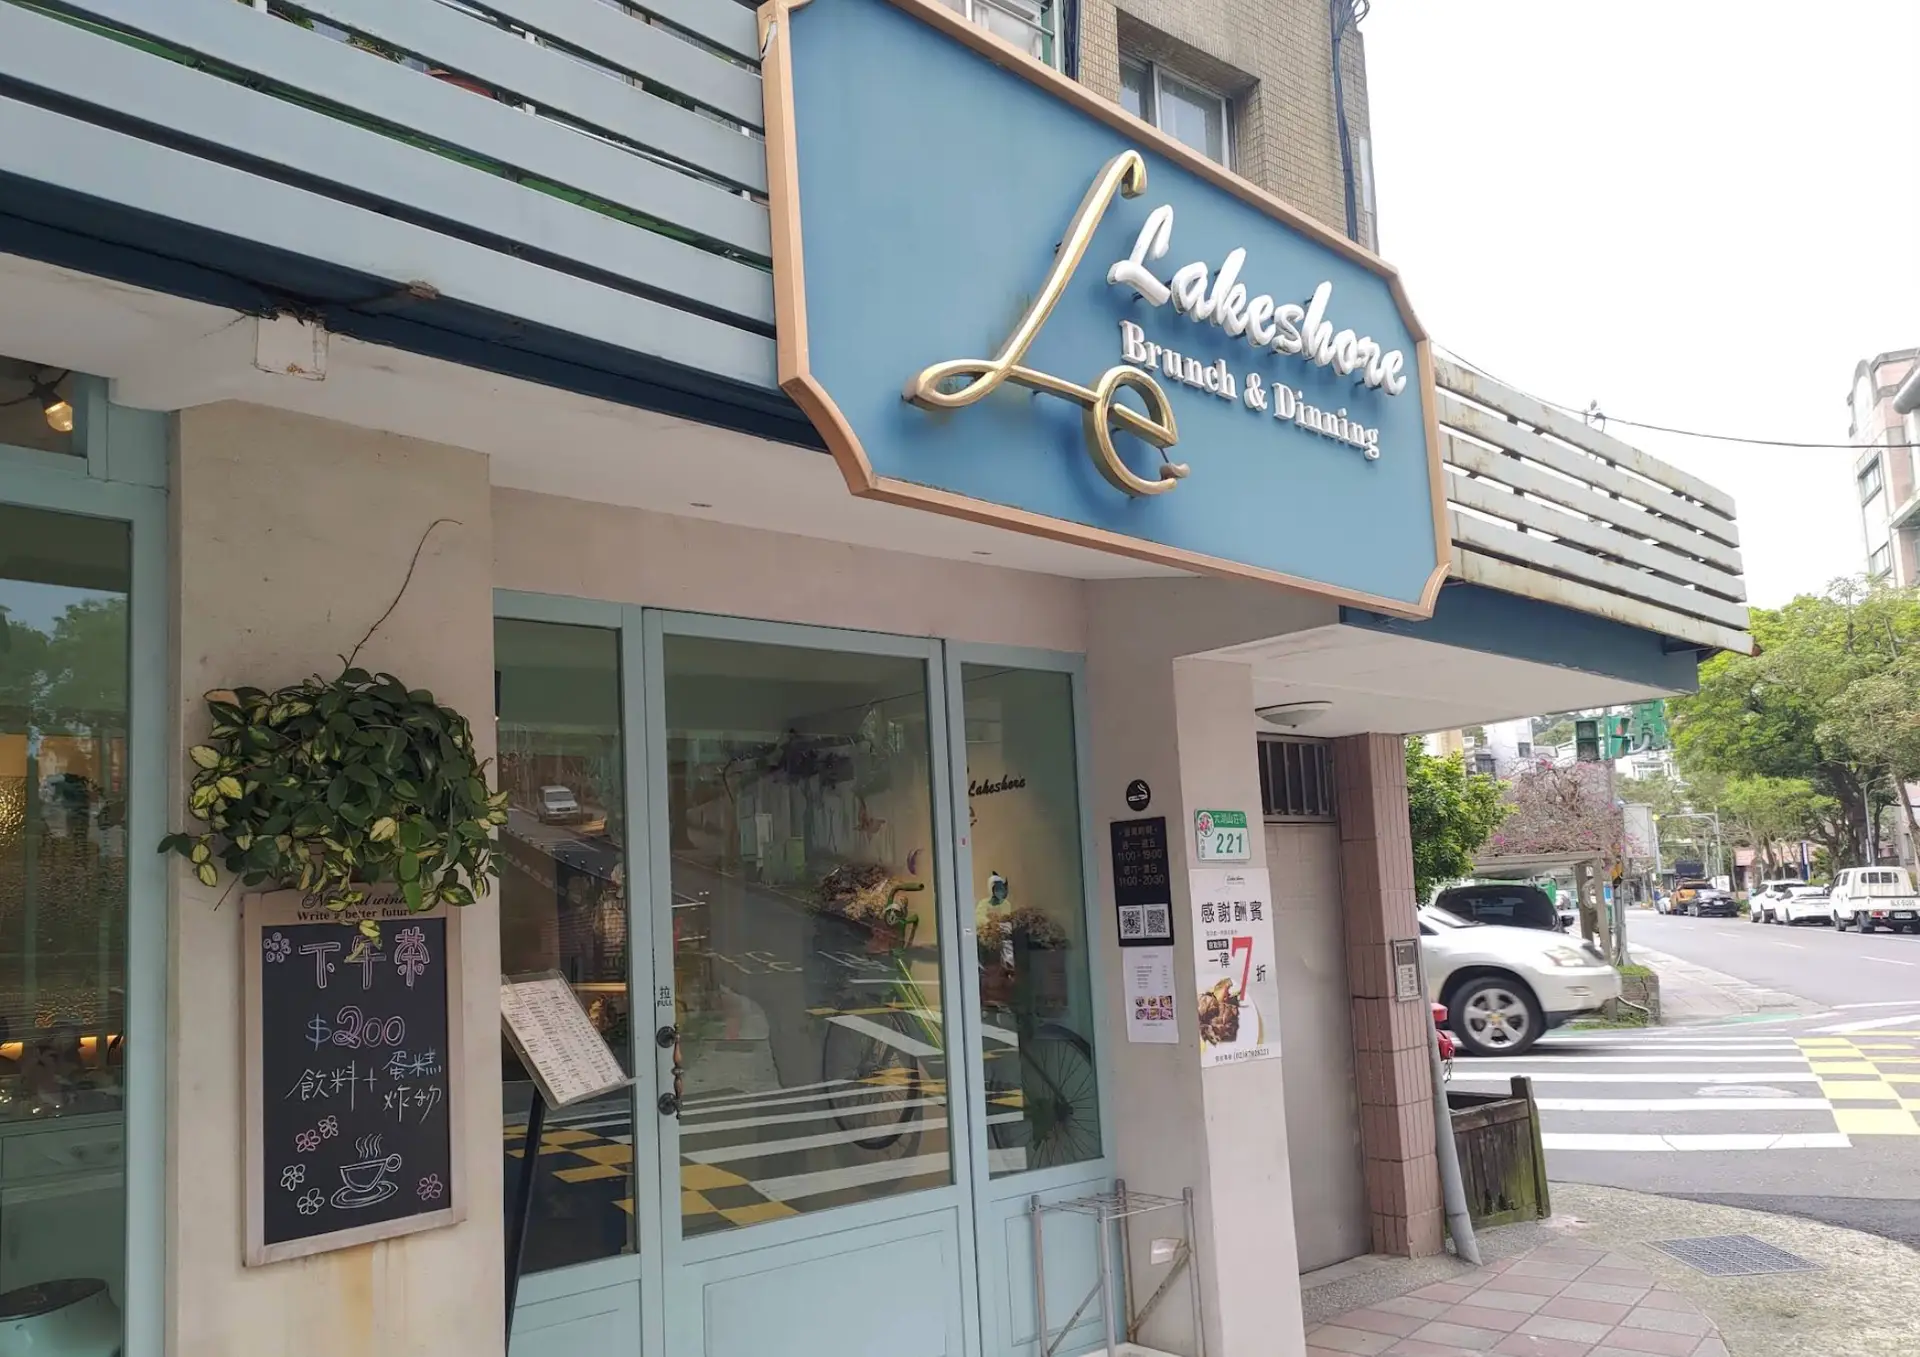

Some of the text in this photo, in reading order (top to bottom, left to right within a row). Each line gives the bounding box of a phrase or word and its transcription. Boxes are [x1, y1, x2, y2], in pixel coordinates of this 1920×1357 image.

[1107, 204, 1407, 396] Lakeshore
[1119, 319, 1381, 461] Brunch & Dinning
[1216, 833, 1243, 854] 221
[297, 910, 330, 921] Write
[382, 908, 409, 917] futur
[1201, 900, 1263, 924] 感謝酬賓
[298, 926, 430, 989] 下午茶
[1209, 952, 1230, 968] 一律
[1232, 936, 1252, 1001] 7
[1256, 964, 1266, 982] 折
[659, 985, 671, 999] 拉
[305, 1006, 406, 1052] $200
[381, 1049, 443, 1079] 蛋糕
[382, 1083, 443, 1124] 炸物
